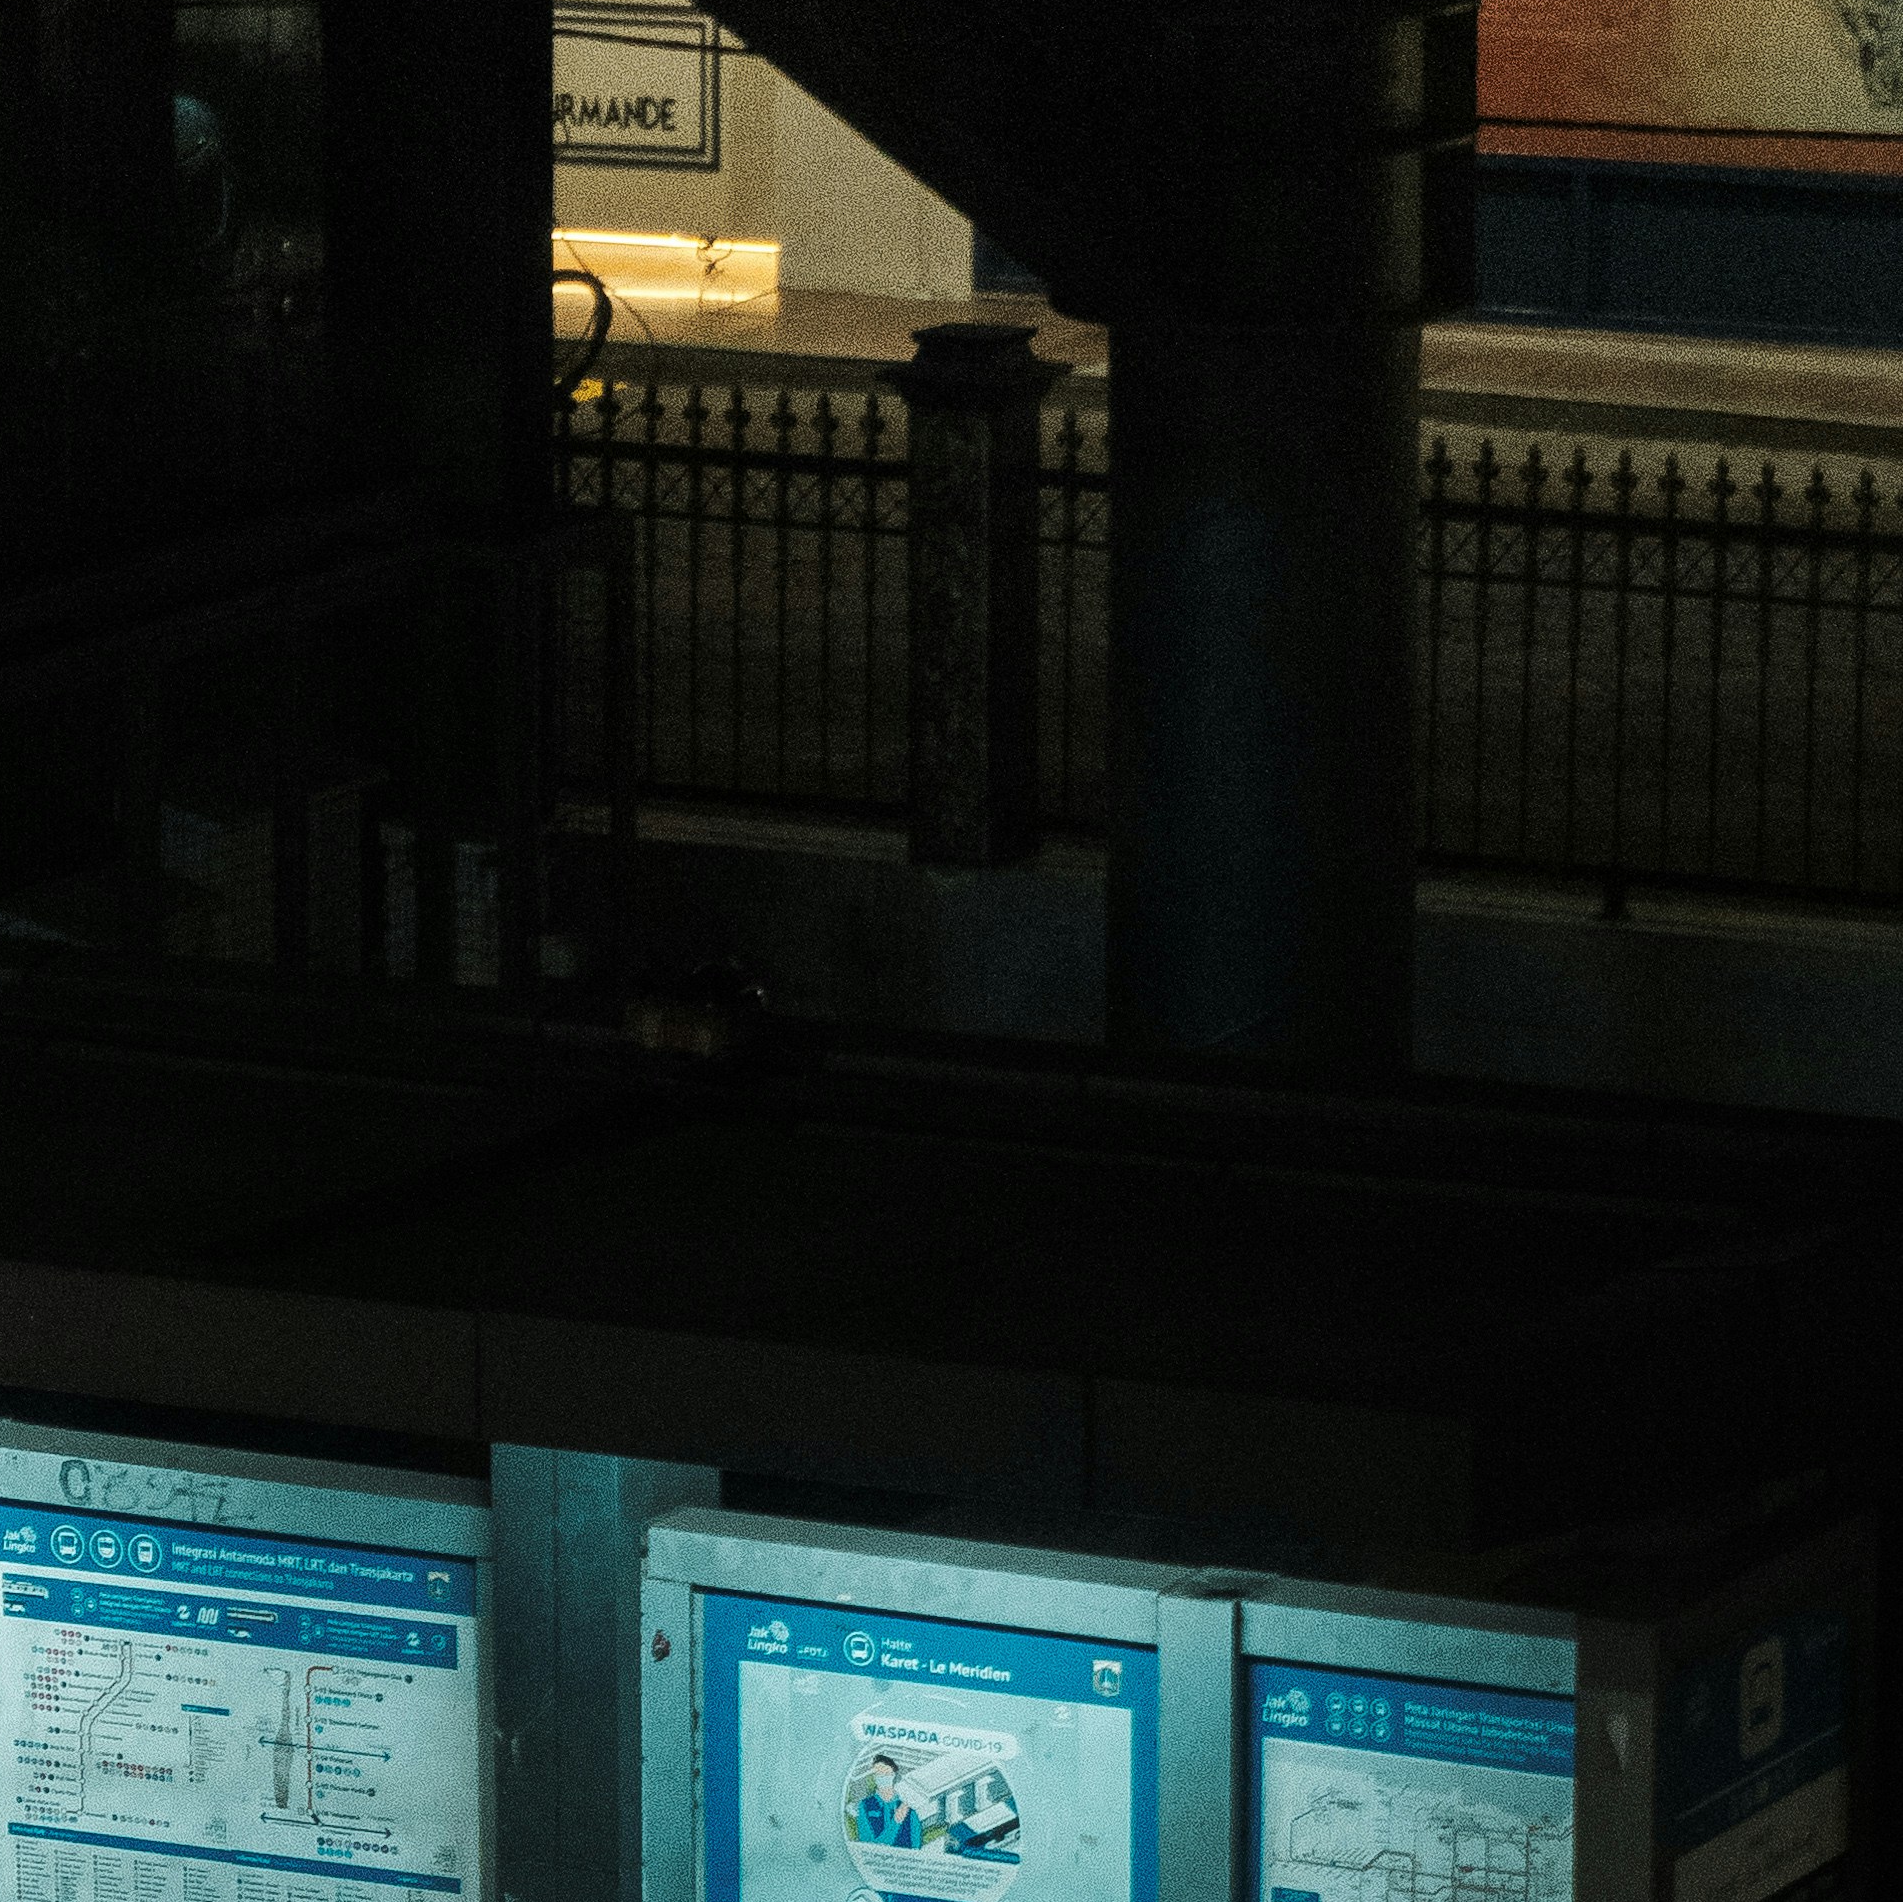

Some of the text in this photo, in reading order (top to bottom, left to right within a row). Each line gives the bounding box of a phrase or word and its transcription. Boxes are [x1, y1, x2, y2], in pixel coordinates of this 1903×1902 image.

[171, 1542, 217, 1561] Integrasi
[219, 1547, 276, 1567] Antarmoda
[881, 1652, 919, 1672] Karet
[929, 1659, 946, 1674] Le
[948, 1662, 1012, 1683] Meridien
[861, 1721, 1004, 1754] WASPADA COVID-19
